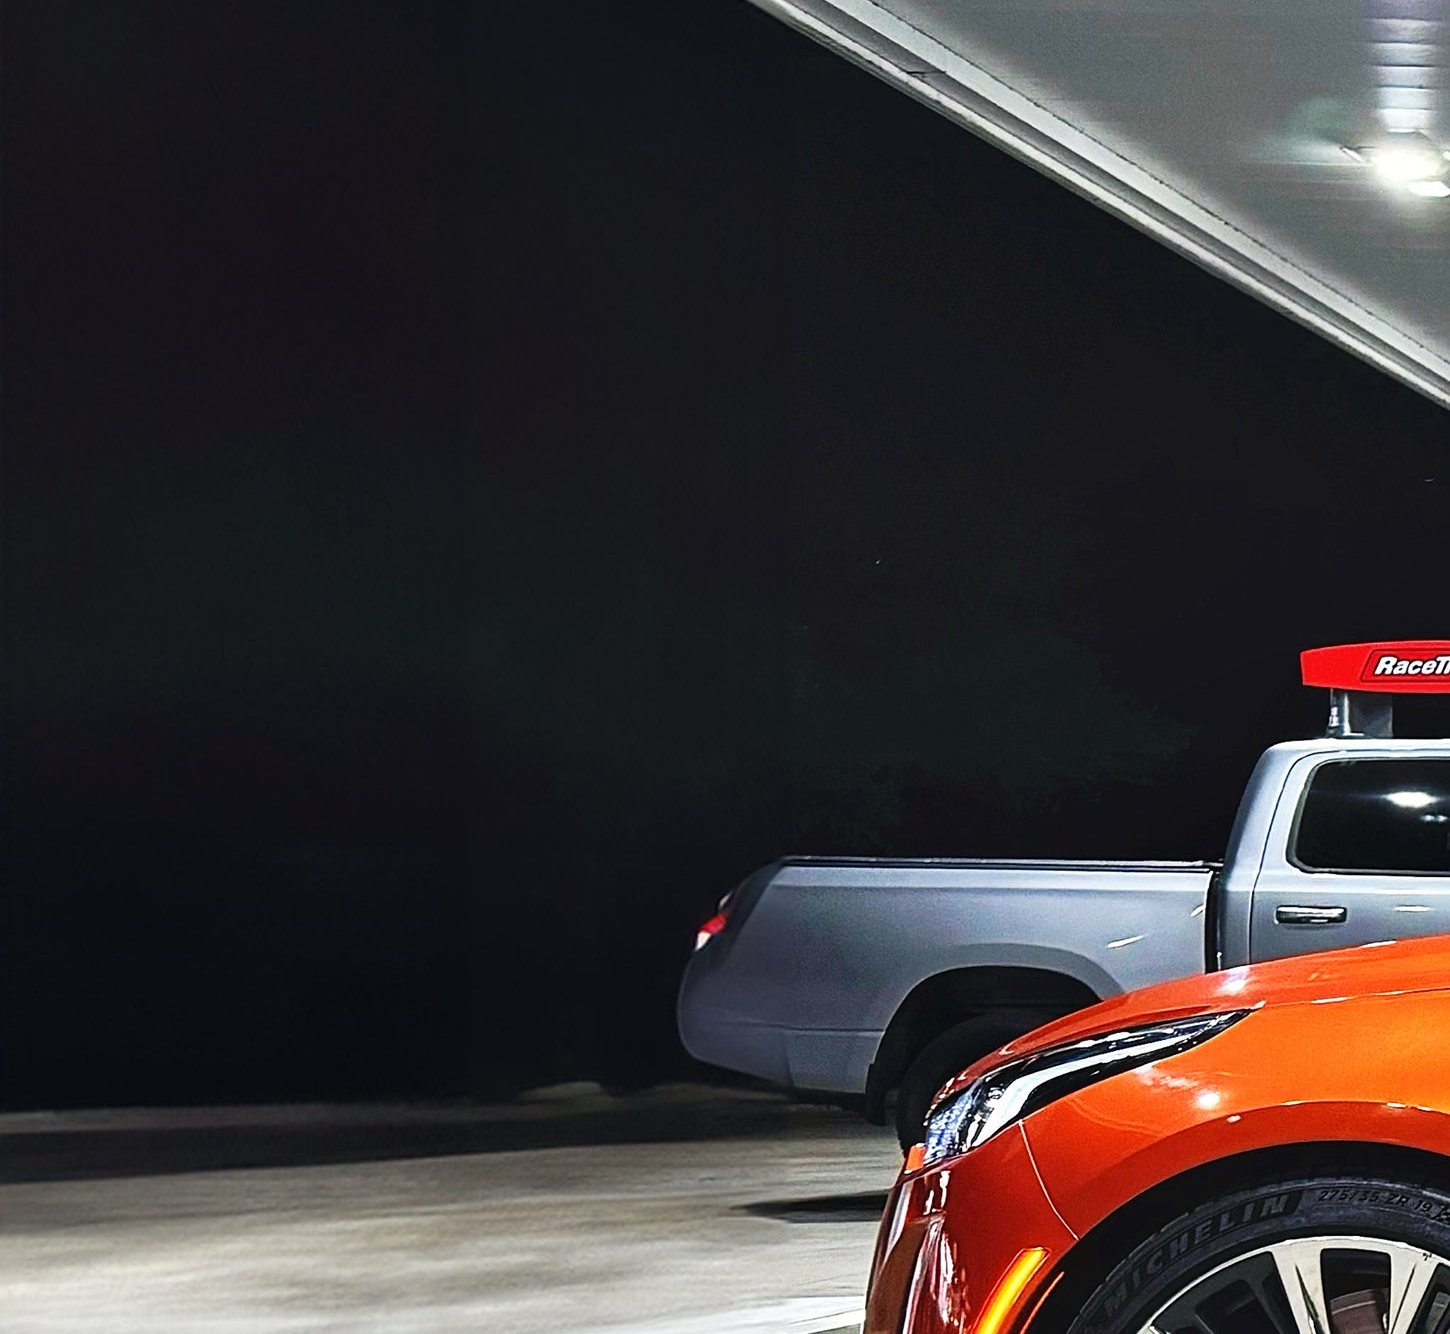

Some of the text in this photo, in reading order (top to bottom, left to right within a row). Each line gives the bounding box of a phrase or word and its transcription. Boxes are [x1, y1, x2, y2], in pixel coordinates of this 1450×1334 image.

[1317, 1188, 1433, 1213] 275/35 ZR 19
[1103, 1192, 1290, 1318] MICHELIN
